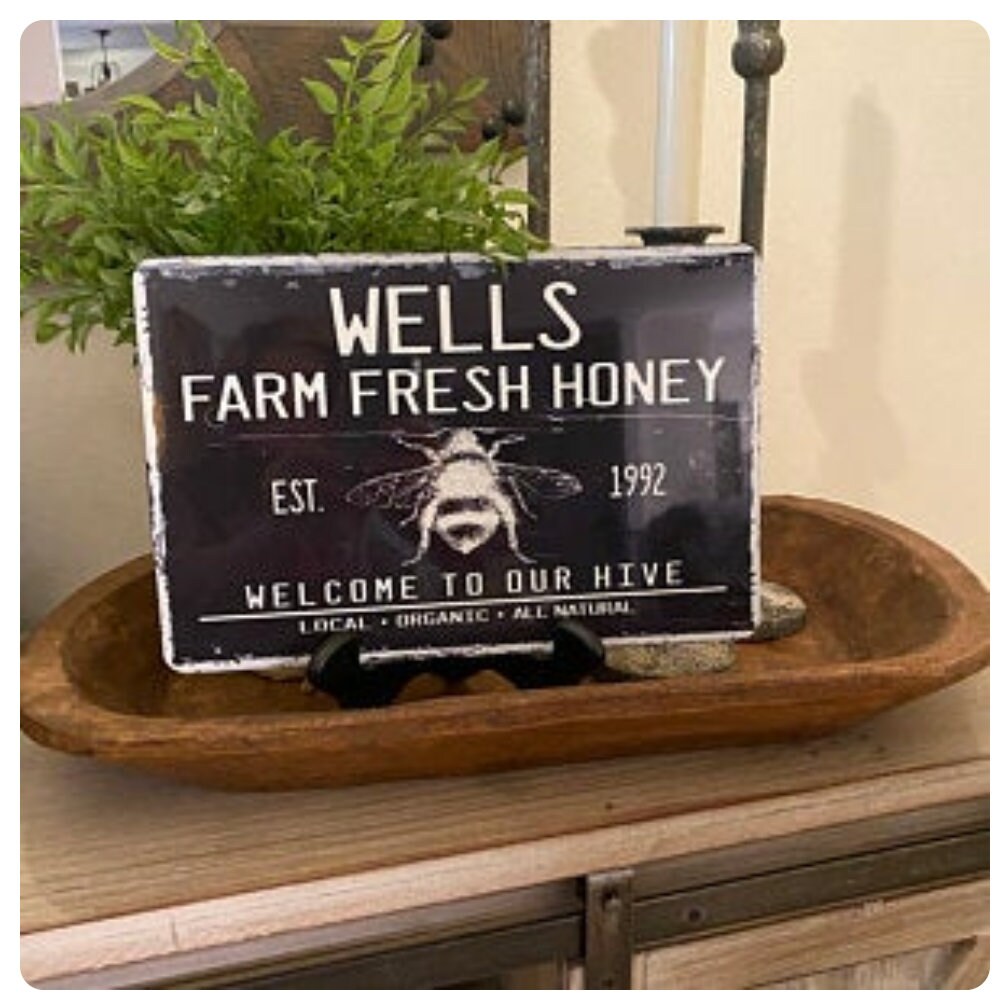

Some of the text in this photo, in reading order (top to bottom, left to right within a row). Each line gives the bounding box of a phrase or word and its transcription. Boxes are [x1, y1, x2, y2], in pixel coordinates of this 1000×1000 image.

[330, 281, 583, 356] WELLS
[181, 357, 726, 422] FARM FRESH HONEY
[271, 479, 324, 515] EST.
[609, 464, 667, 498] 1992
[245, 560, 684, 610] WELCOME TO OUR HIVE
[300, 600, 635, 635] LOCAL ORGANIC ALL NATURAL
